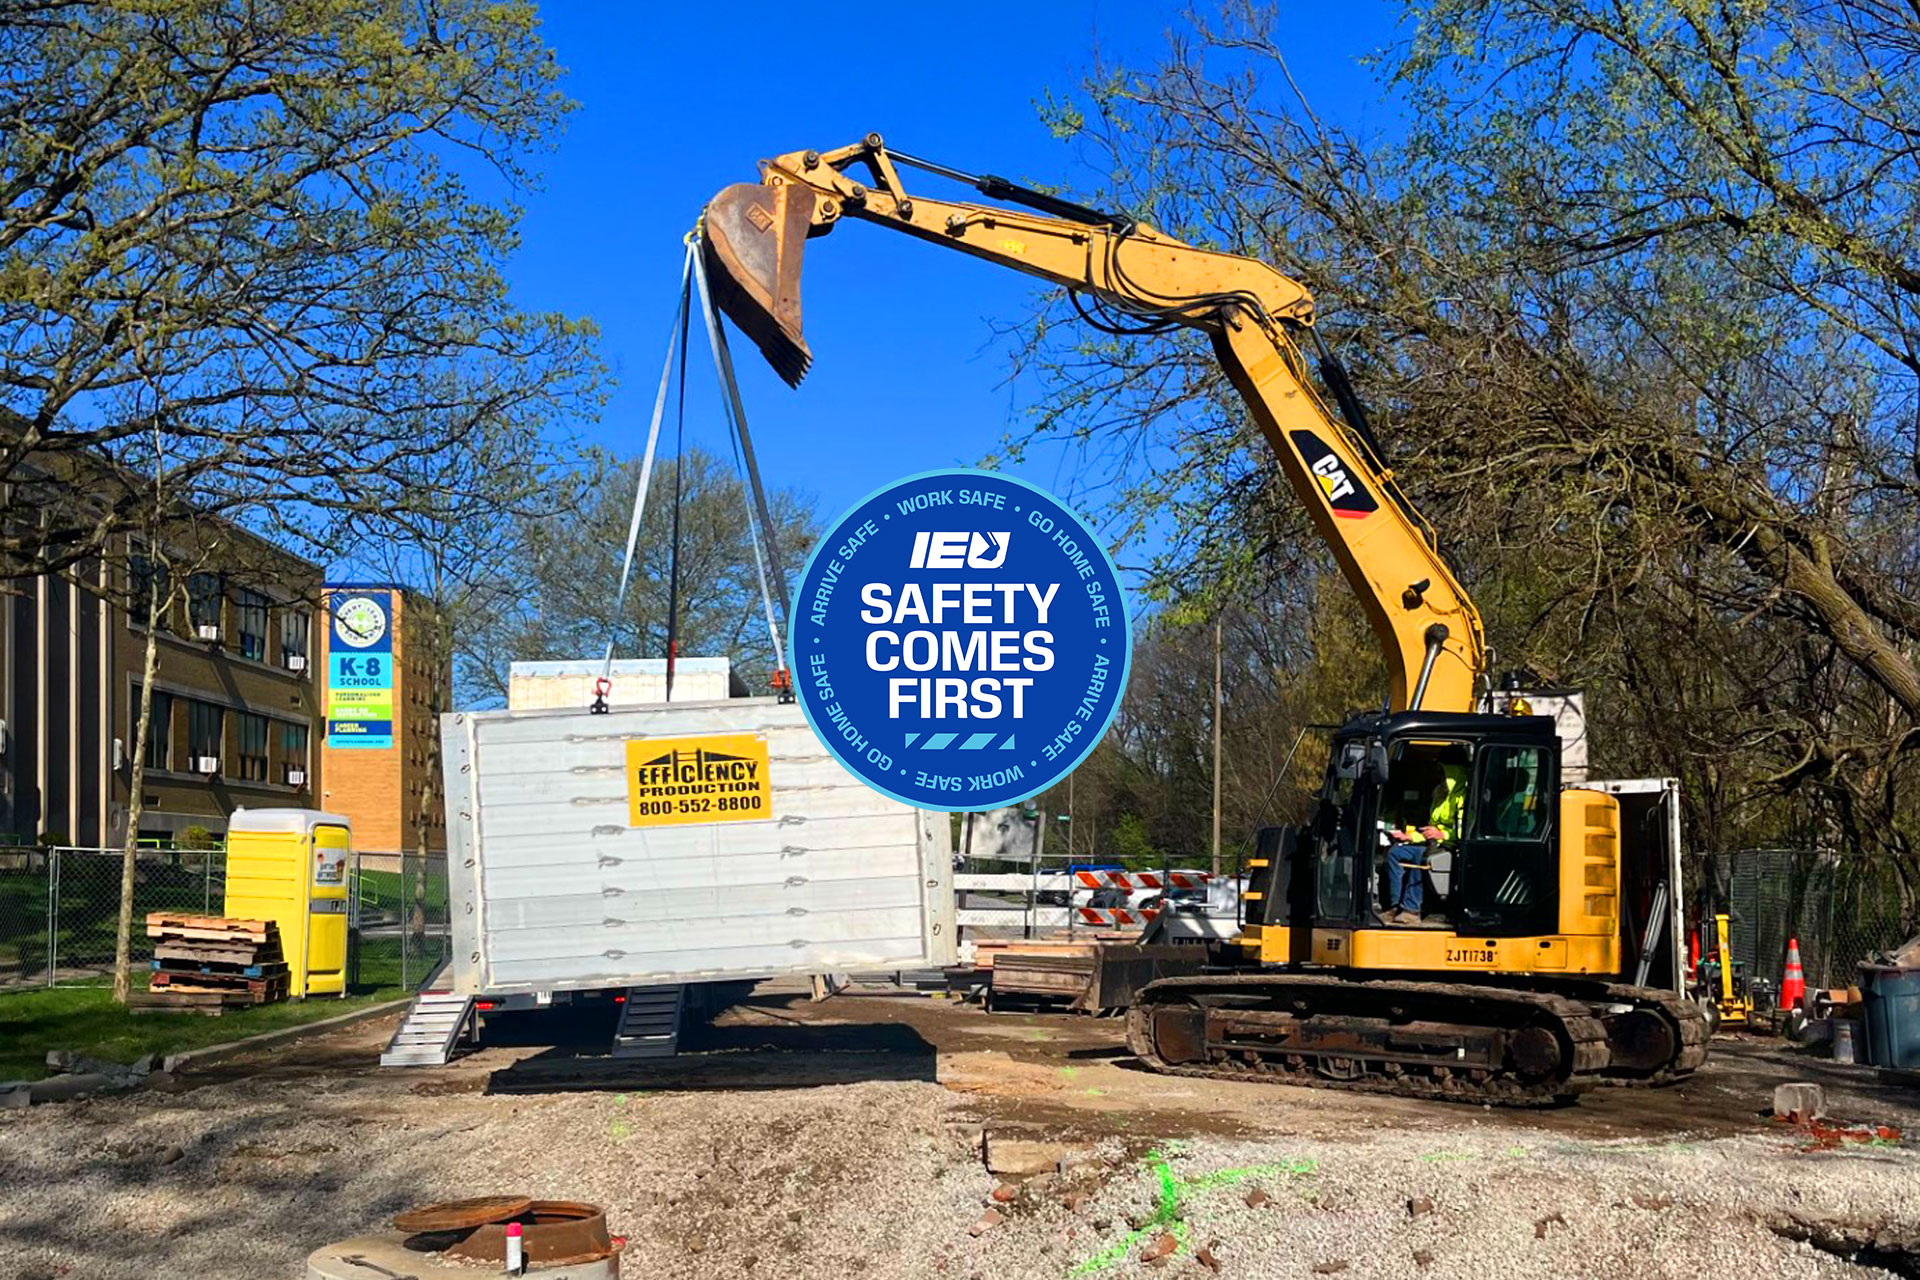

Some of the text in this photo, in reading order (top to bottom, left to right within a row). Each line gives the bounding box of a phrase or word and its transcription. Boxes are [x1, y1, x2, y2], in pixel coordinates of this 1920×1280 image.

[1312, 454, 1355, 502] CAT
[339, 657, 381, 677] K-8
[339, 677, 382, 687] SCHOOL
[638, 748, 758, 785] EFFICIENCY
[640, 782, 759, 797] PRODUCTION
[640, 795, 761, 815] 800-552-8800
